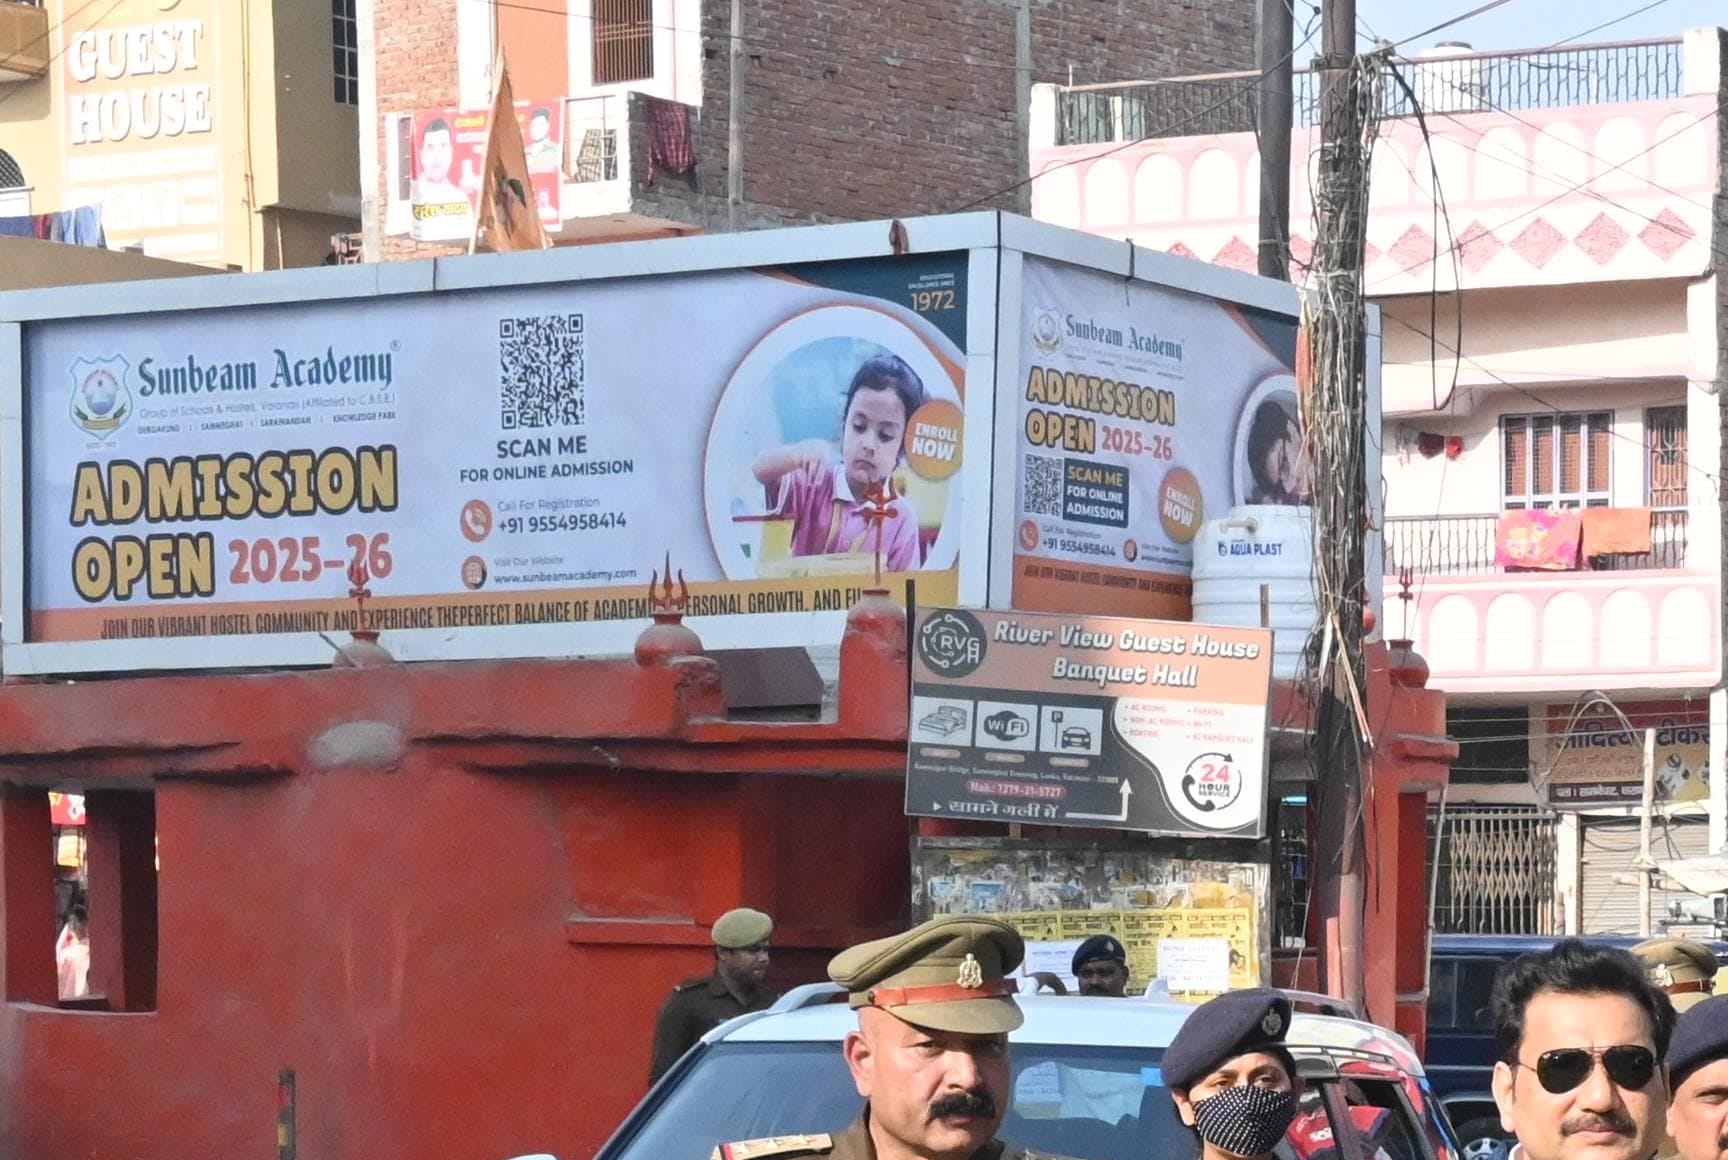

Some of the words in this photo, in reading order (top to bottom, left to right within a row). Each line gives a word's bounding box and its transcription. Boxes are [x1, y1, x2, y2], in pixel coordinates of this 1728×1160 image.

[68, 20, 203, 82] GUEST
[71, 84, 212, 145] HOUSE
[911, 290, 955, 311] 1972
[1066, 314, 1123, 347] Sunbeam
[1128, 326, 1182, 362] Academy
[138, 354, 257, 397] Sunbeam
[270, 346, 392, 390] Academy
[1026, 366, 1175, 426] ADMISSION
[1025, 408, 1096, 454] OPEN
[1102, 426, 1173, 461] 2025-26
[497, 438, 551, 459] SCAN
[558, 435, 587, 455] ME
[912, 437, 955, 461] NOW
[460, 468, 489, 483] FOR
[493, 465, 546, 481] ONLINE
[550, 460, 634, 478] ADMISSION
[1068, 466, 1101, 484] SCAN
[1105, 471, 1123, 487] ME
[70, 445, 398, 527] ADMISSION
[1067, 485, 1087, 498] FOR
[1088, 487, 1123, 504] ONLINE
[497, 500, 517, 513] Call
[519, 500, 536, 511] For
[538, 497, 601, 512] Registration
[1066, 502, 1124, 521] ADMISSION
[1163, 501, 1194, 527] NOW
[499, 517, 524, 534] +91
[528, 512, 627, 533] 9554958414
[512, 557, 528, 566] Our
[1230, 543, 1252, 556] AQUA
[1254, 543, 1282, 556] PLAST
[72, 532, 215, 602] OPEN
[228, 533, 393, 584] 2025-26
[494, 568, 638, 585] www.sunbeamacademy.com
[101, 619, 128, 640] JOIN
[131, 618, 154, 638] OUR
[158, 615, 207, 637] VIBRANT
[211, 614, 251, 635] HOSTEL
[255, 611, 329, 634] COMMUNITY
[333, 610, 358, 631] AND
[515, 600, 570, 624] BALANCE
[574, 600, 589, 621] OF
[814, 589, 841, 611] AND
[993, 620, 1053, 646] River
[1059, 623, 1113, 650] View
[1118, 628, 1186, 654] Guest
[1191, 632, 1259, 659] House
[1051, 657, 1147, 689] Banquet
[1152, 663, 1198, 687] Hall
[1201, 763, 1231, 784] 24
[1199, 783, 1231, 792] HOUR
[1002, 803, 1040, 818] गली
[1043, 804, 1060, 819] में
